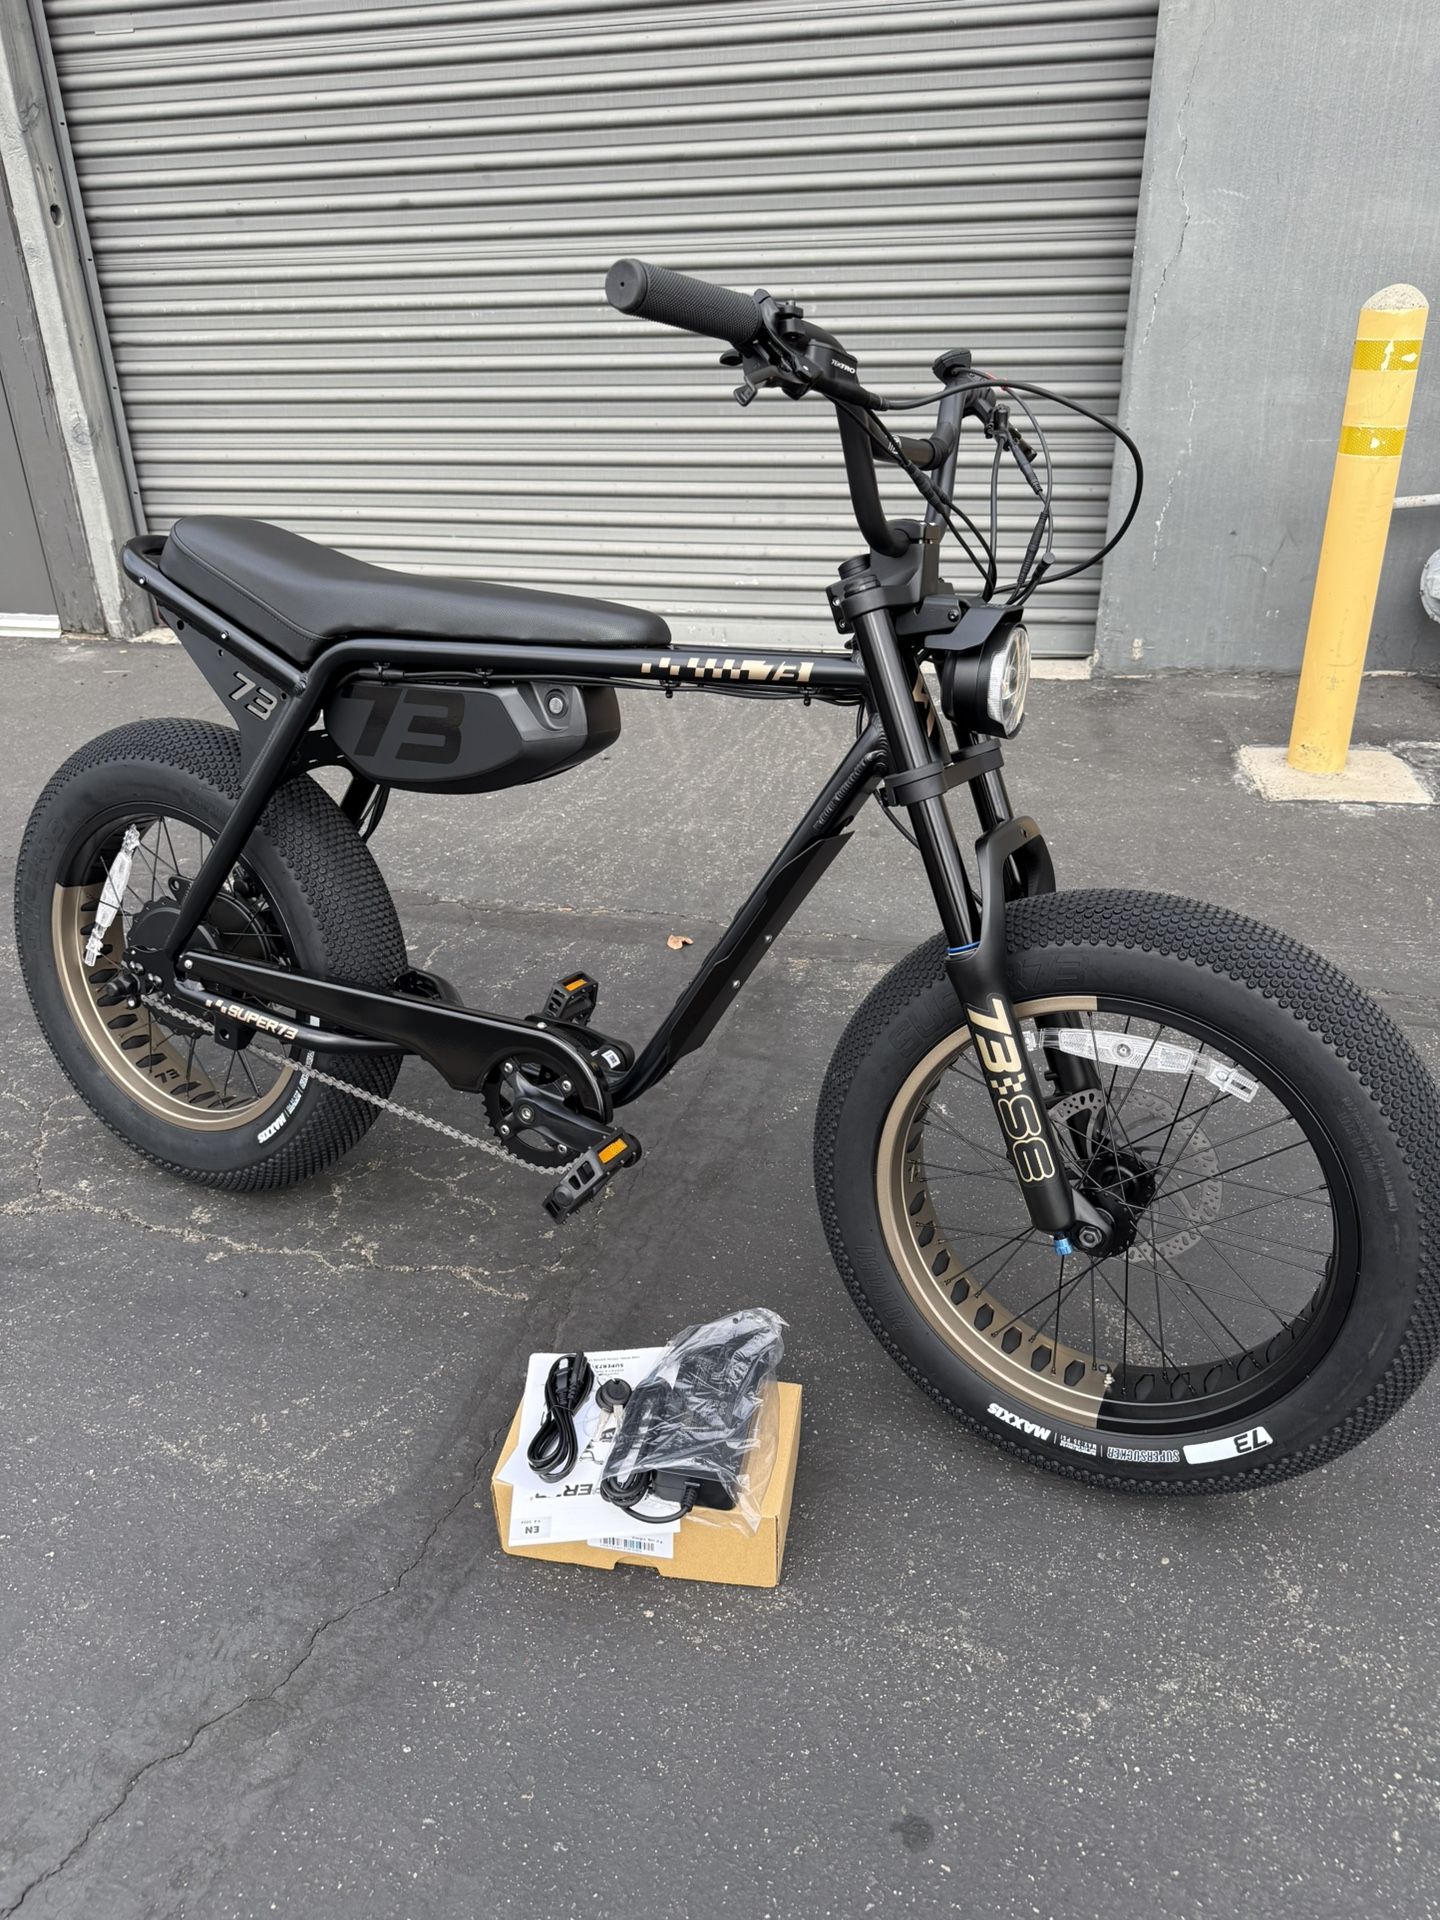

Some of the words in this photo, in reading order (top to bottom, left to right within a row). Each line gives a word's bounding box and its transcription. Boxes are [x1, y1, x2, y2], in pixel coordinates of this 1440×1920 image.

[228, 671, 278, 722] 73
[341, 685, 466, 765] 73
[227, 1004, 299, 1041] SUPER73
[967, 998, 1022, 1074] 73
[154, 1069, 180, 1083] 73
[987, 1402, 1051, 1441] MAXXIS
[1106, 1446, 1181, 1463] SUPERSUCKER
[1233, 1428, 1269, 1454] 73
[525, 1525, 540, 1535] EN
